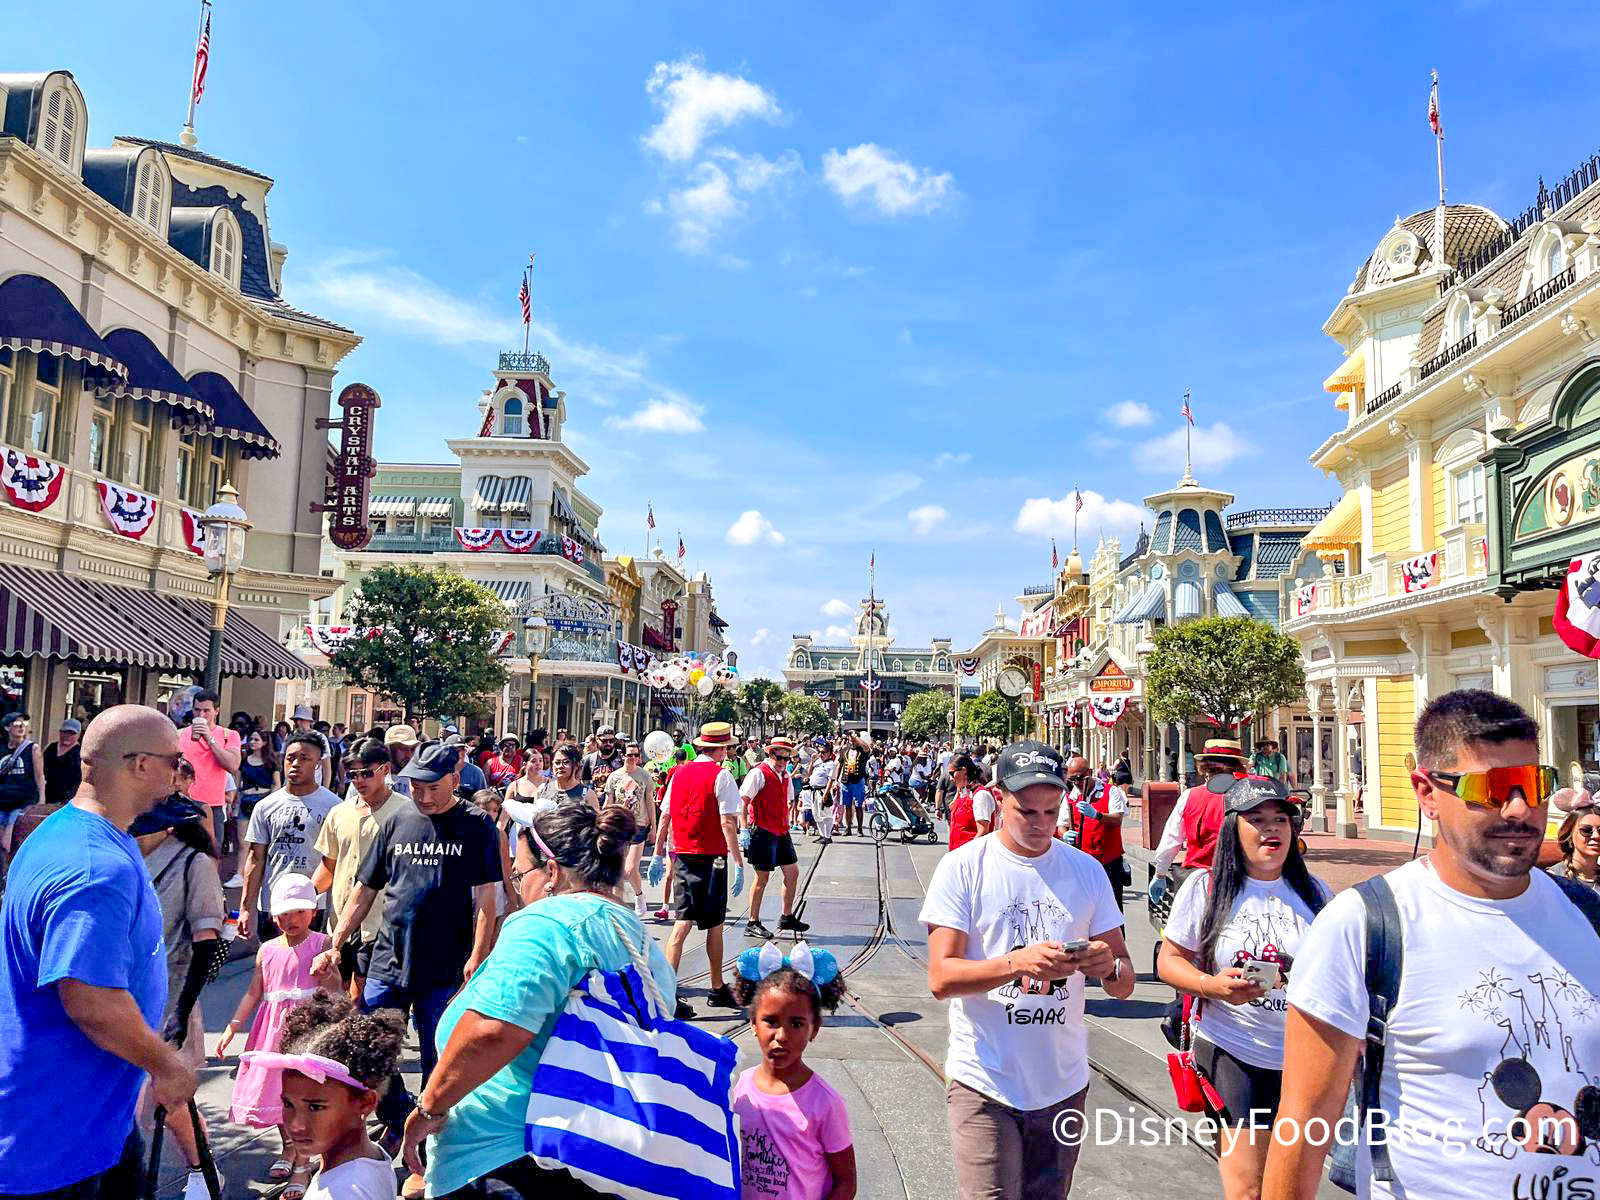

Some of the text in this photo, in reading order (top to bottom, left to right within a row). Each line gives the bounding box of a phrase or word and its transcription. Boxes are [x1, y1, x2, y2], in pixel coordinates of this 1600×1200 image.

[342, 406, 363, 526] CRYSTAL ARTS
[1092, 679, 1132, 689] EMPORIUM
[1011, 750, 1059, 772] Disney
[394, 842, 463, 857] BALMAIN
[411, 857, 440, 866] PARIS
